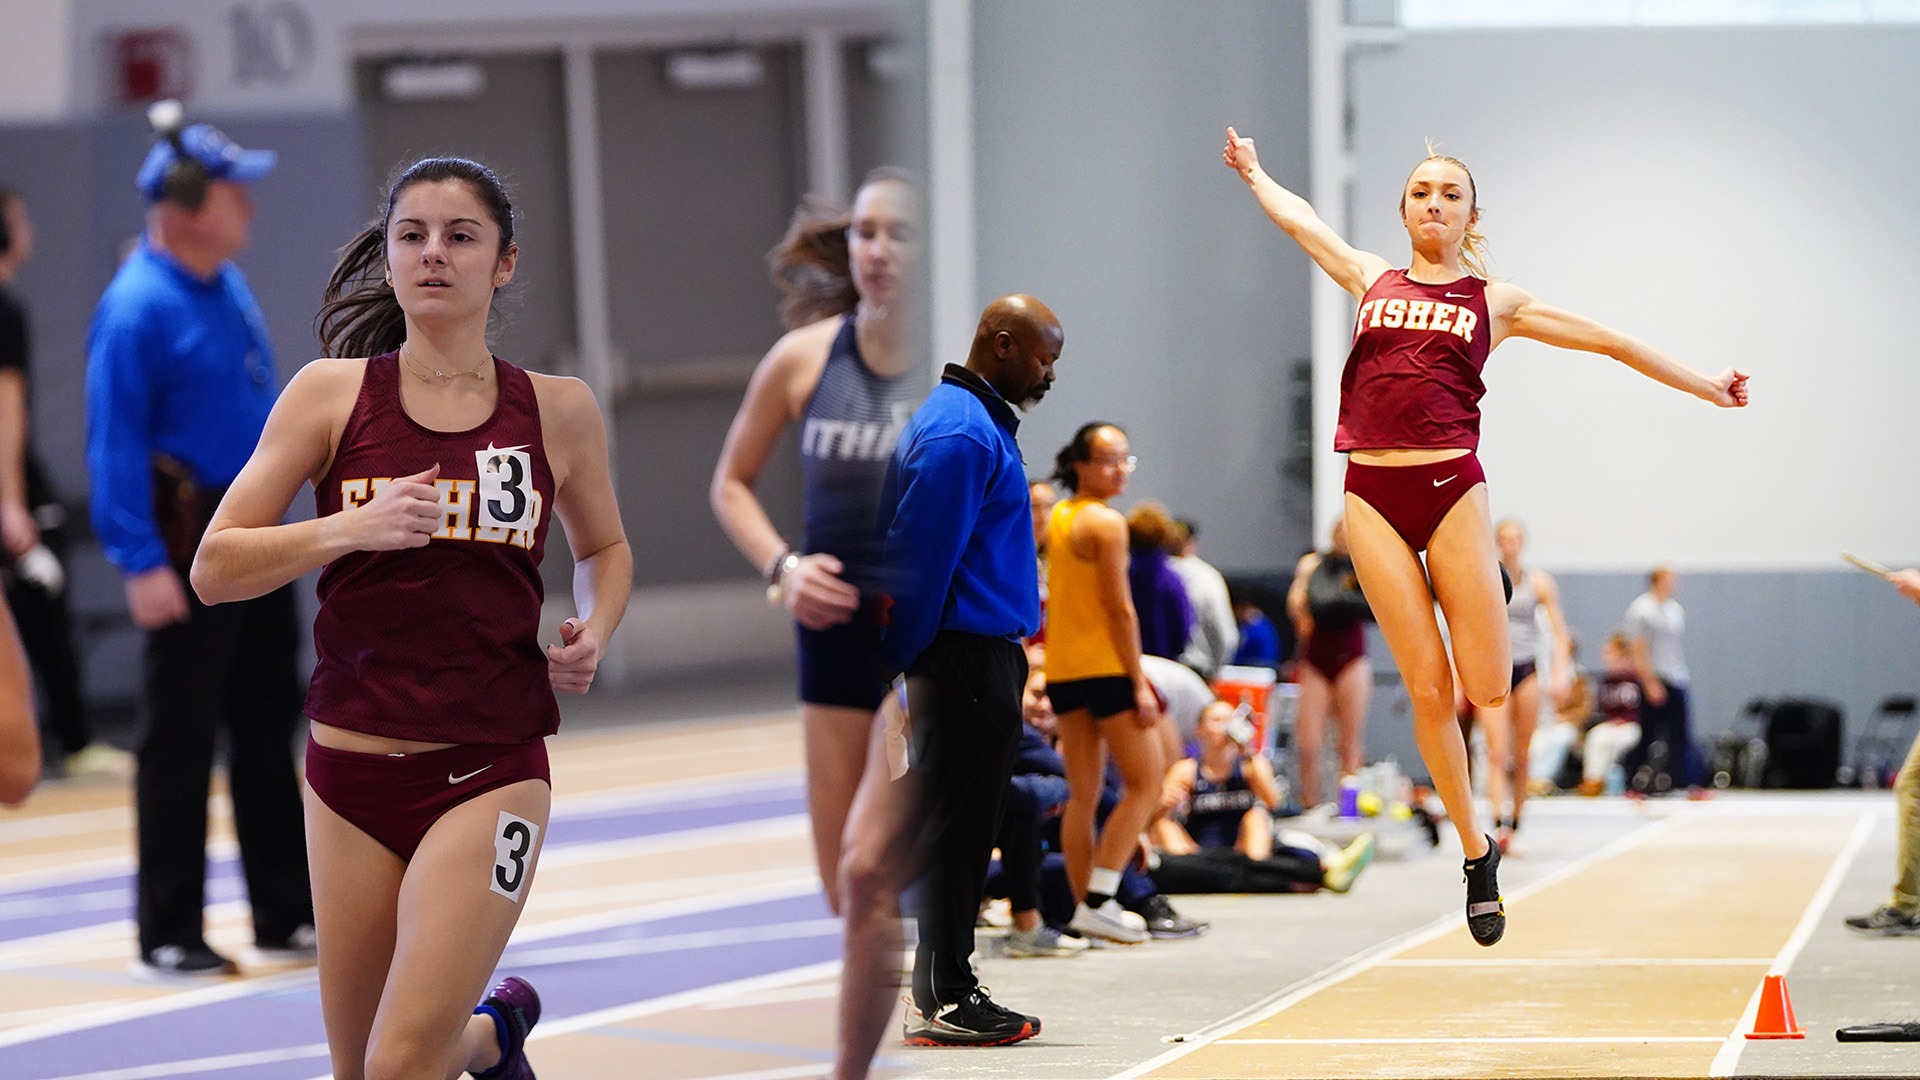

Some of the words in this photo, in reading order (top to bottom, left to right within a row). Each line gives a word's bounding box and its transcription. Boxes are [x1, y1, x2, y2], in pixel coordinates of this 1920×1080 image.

[1357, 298, 1478, 343] FISHER
[486, 454, 526, 523] 3
[496, 821, 530, 893] 3
